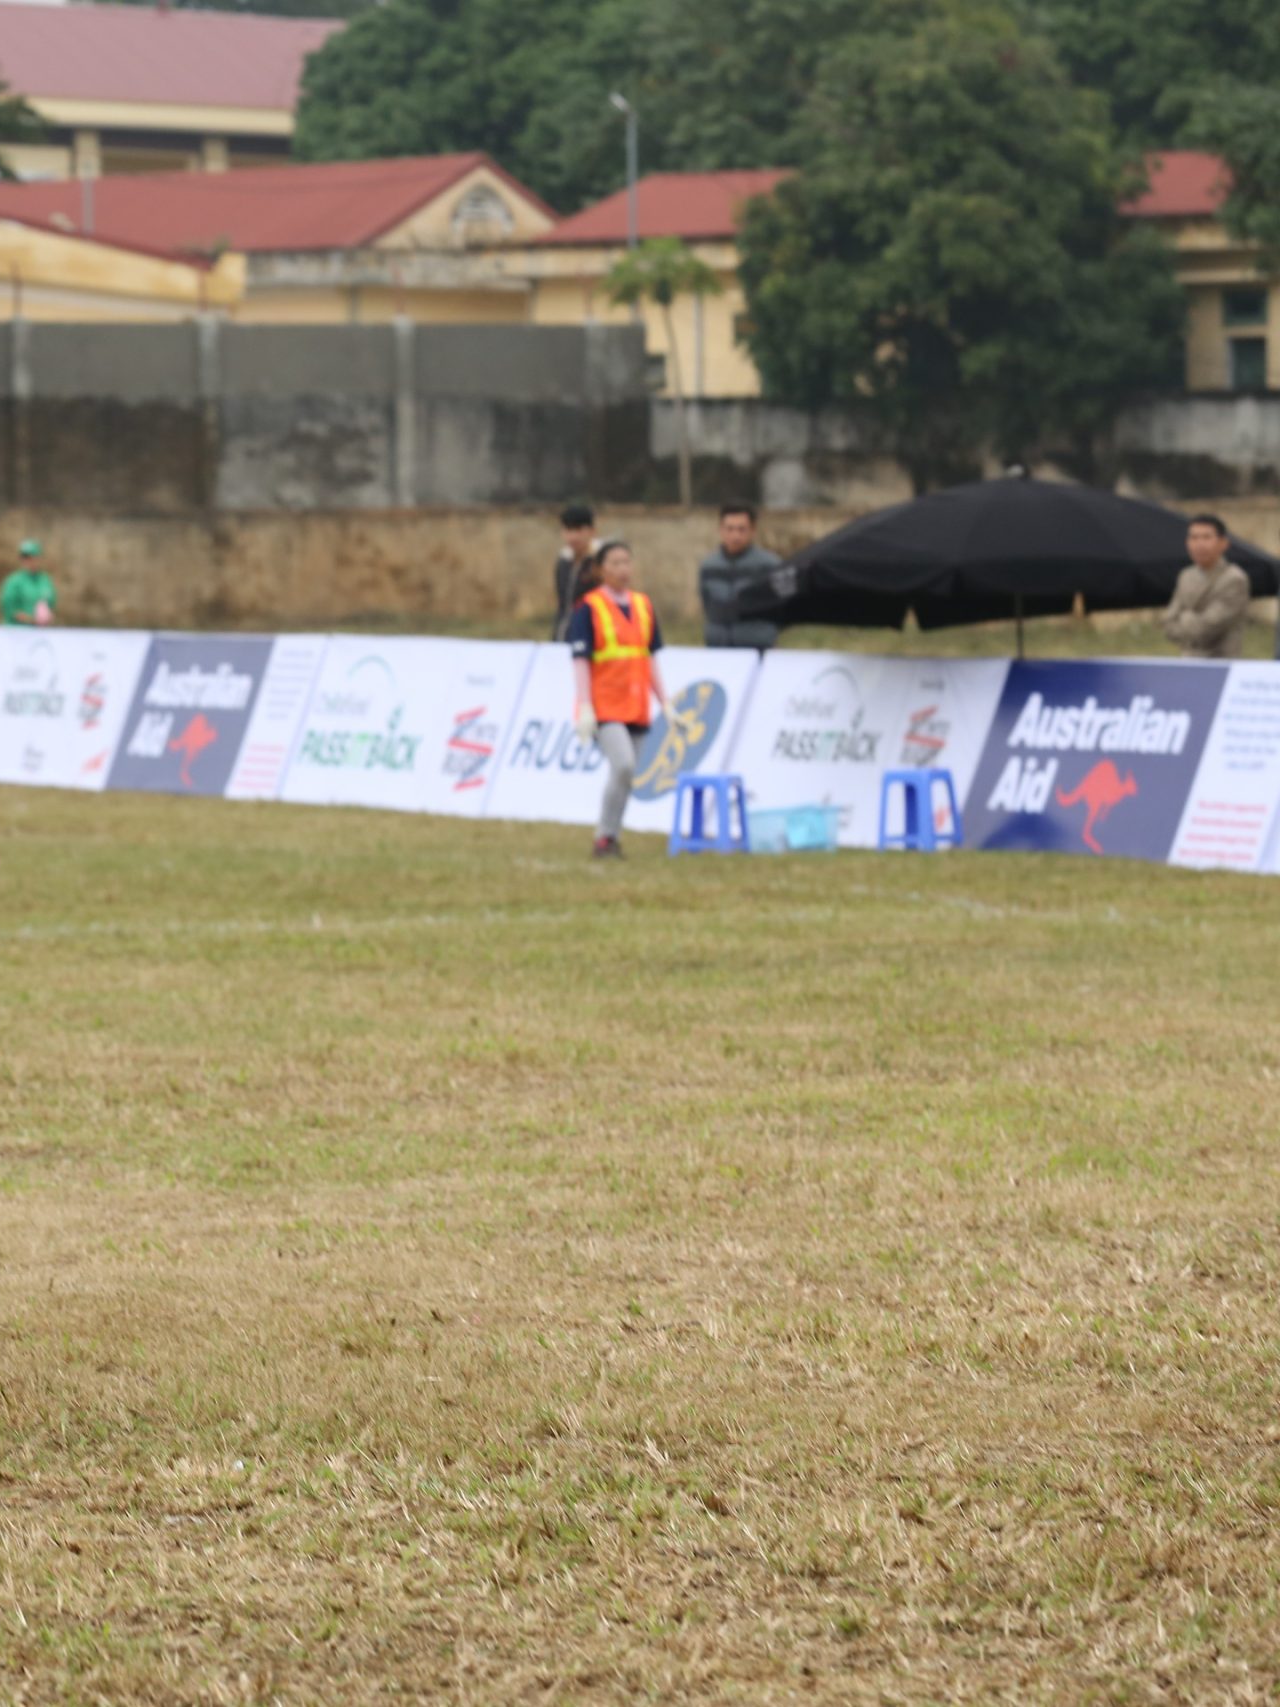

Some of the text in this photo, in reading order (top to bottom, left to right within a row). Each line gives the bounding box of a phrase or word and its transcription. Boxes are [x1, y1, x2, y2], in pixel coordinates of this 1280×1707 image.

[510, 718, 608, 772] RUGB
[1007, 692, 1191, 755] Australian
[987, 756, 1059, 813] Aid
